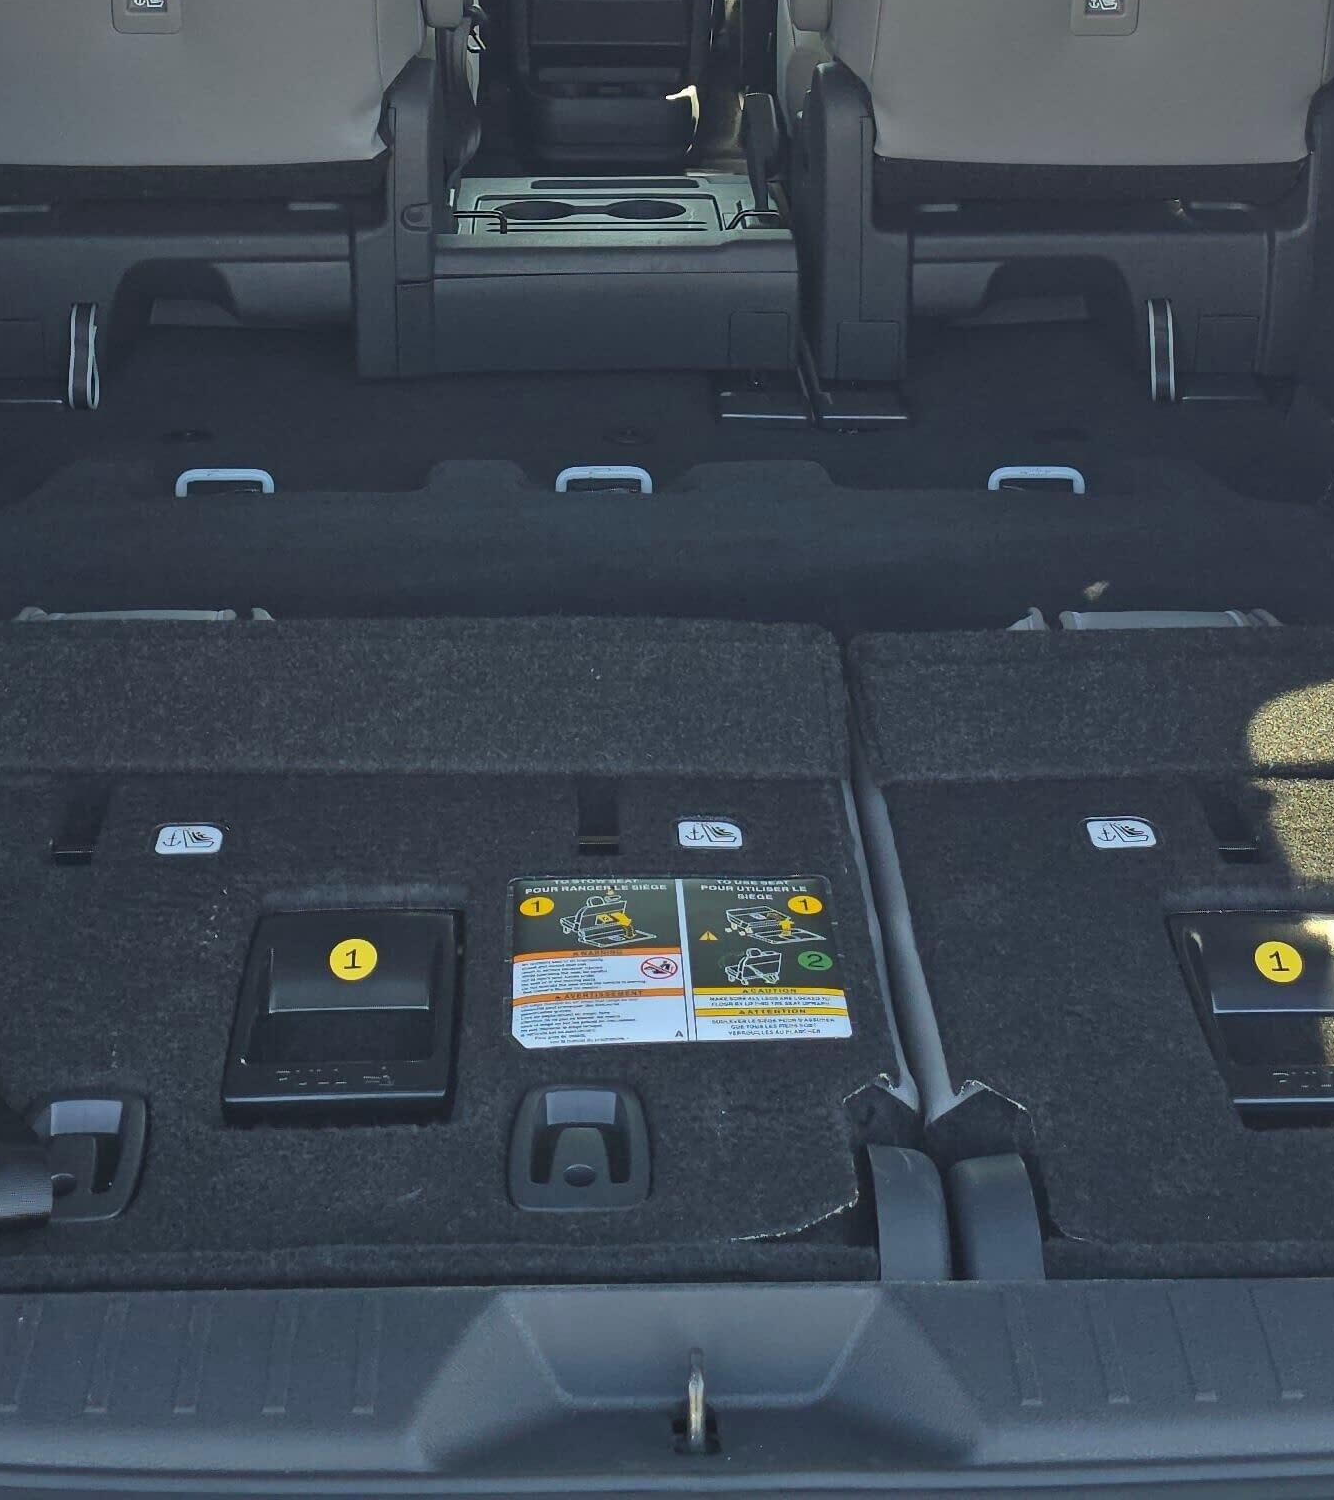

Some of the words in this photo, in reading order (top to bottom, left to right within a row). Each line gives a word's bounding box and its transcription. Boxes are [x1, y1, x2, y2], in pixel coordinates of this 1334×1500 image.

[525, 886, 559, 895] POUR
[531, 901, 540, 912] 1
[798, 899, 808, 911] 1
[343, 949, 362, 970] 1
[806, 953, 823, 968] 2
[1268, 950, 1290, 972] 1
[564, 990, 644, 1000] AVERTISSEMENT
[675, 1029, 684, 1038] A
